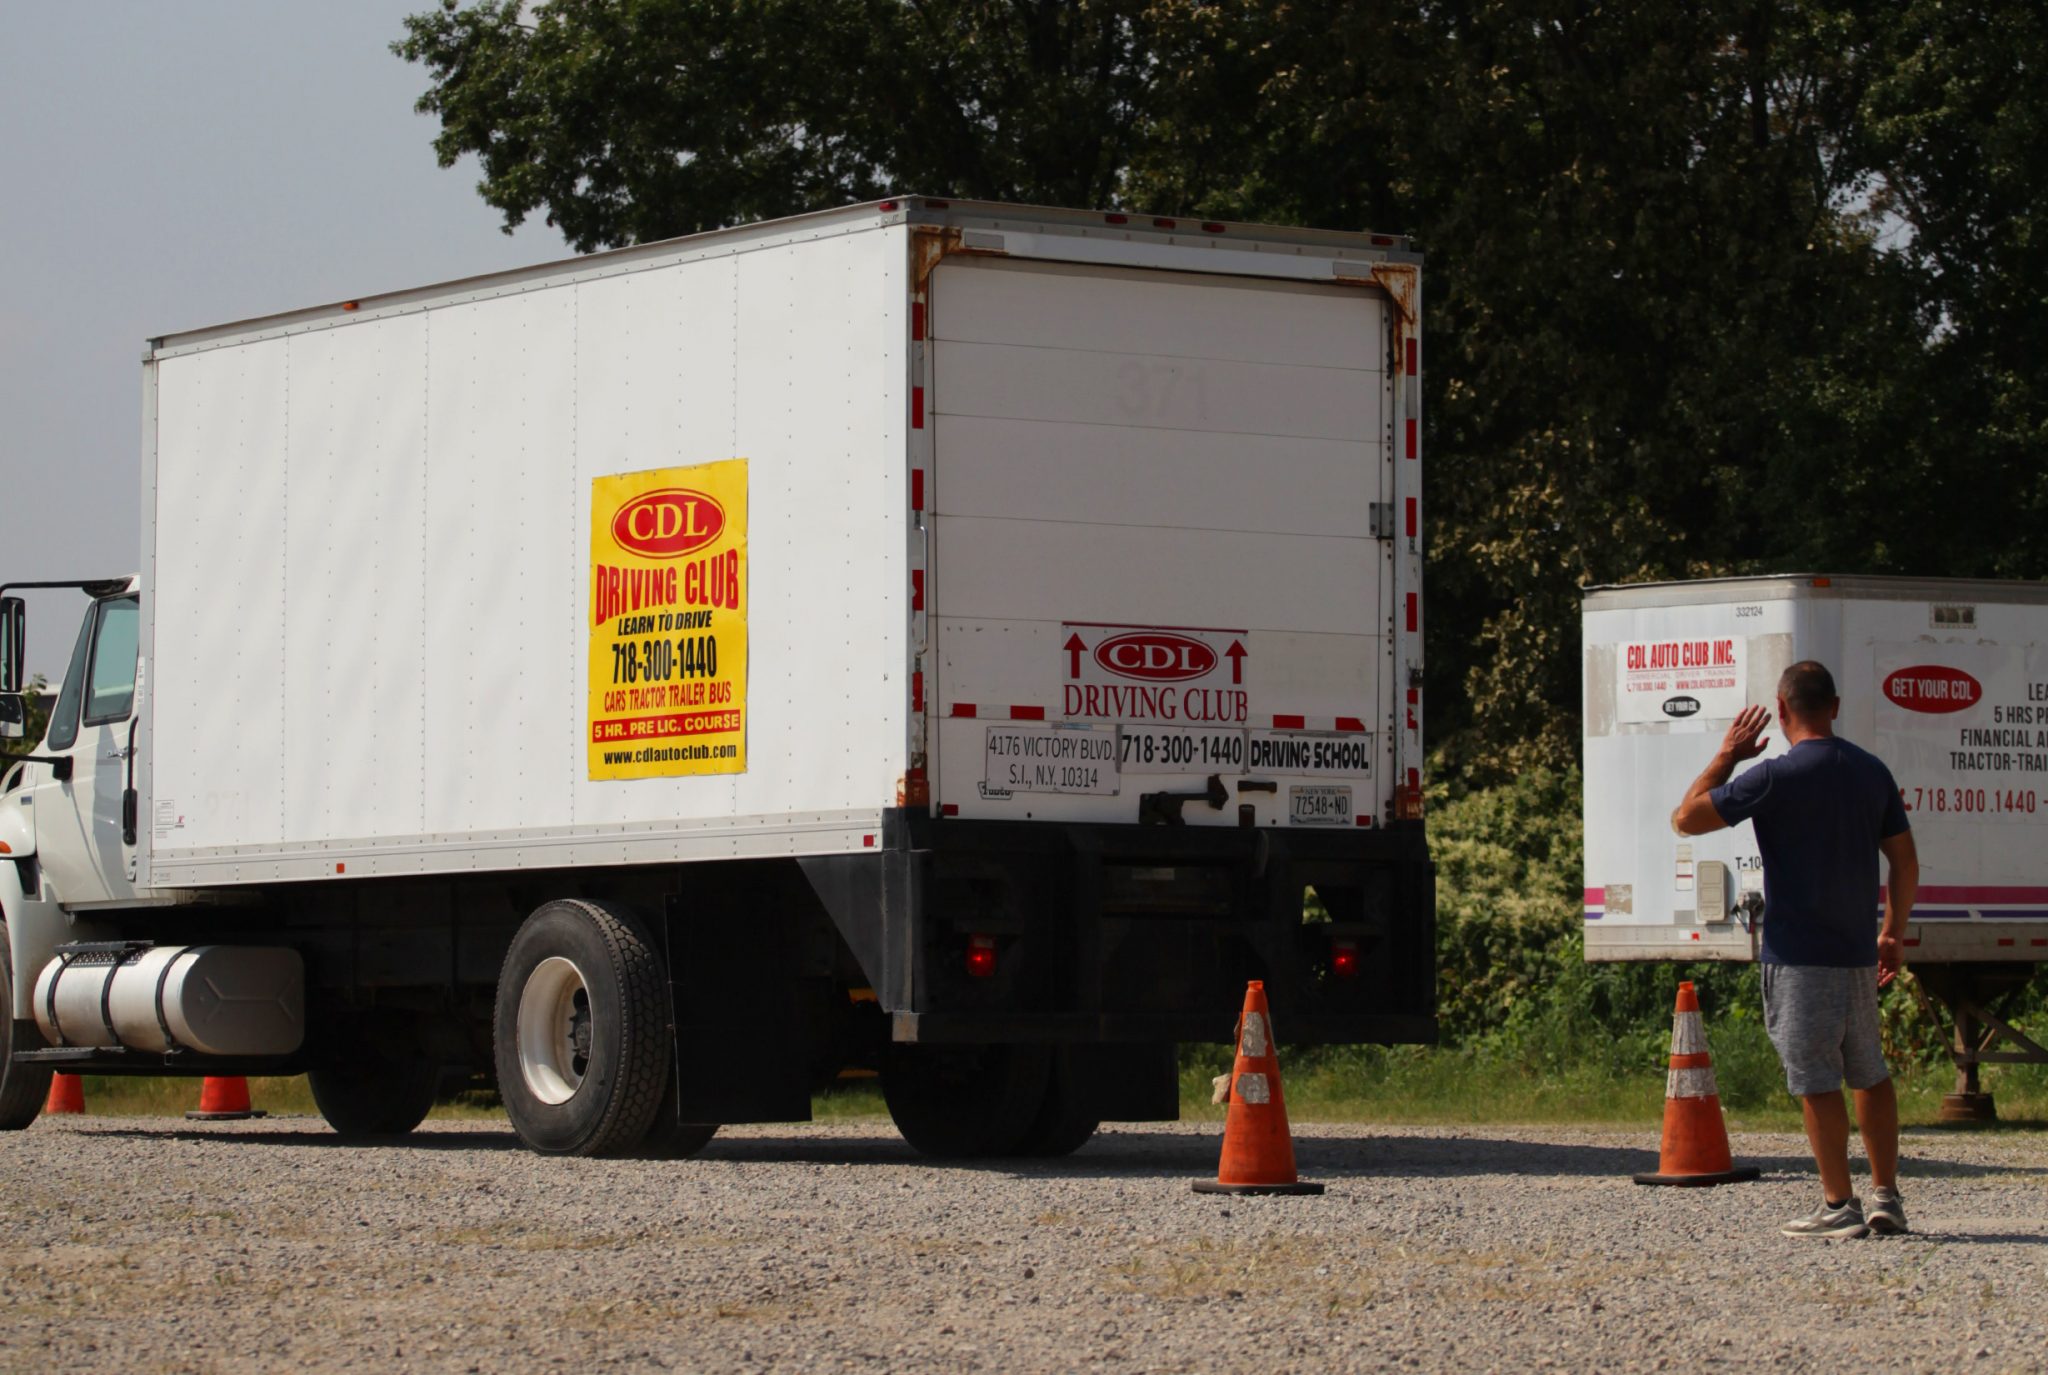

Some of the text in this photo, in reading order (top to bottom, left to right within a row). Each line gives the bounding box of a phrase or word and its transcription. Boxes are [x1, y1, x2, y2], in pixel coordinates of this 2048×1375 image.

[628, 500, 708, 541] CDL
[595, 548, 739, 626] DRIVING CLUB
[618, 610, 712, 636] LEARN TO DRIVE
[1736, 606, 1763, 617] 332124
[612, 635, 717, 684] 718-300-1440
[1109, 642, 1205, 672] CDL
[1628, 640, 1736, 670] CDL AUTO CLUB INC.
[604, 681, 731, 713] CARS TRACTOR TRAILER BUS
[1891, 677, 1974, 701] GET YOUR CDL
[1064, 684, 1248, 723] DRIVING CLUB
[1994, 706, 2048, 725] 5 HRS P
[594, 712, 740, 739] 5 HR. PRE LIC. COURSE
[1961, 728, 2048, 748] FINANCIAL A
[603, 745, 738, 765] www.cdlautoclub.com
[989, 735, 1117, 761] 4176 VICTORY BLVD.
[1122, 734, 1243, 765] 718-300-1440
[1251, 742, 1369, 770] DRIVING SCHOOL
[1950, 752, 2048, 772] TRACTOR-TRAI
[1009, 763, 1098, 789] S.I., N.Y. 10314
[1735, 856, 1764, 870] T-10
